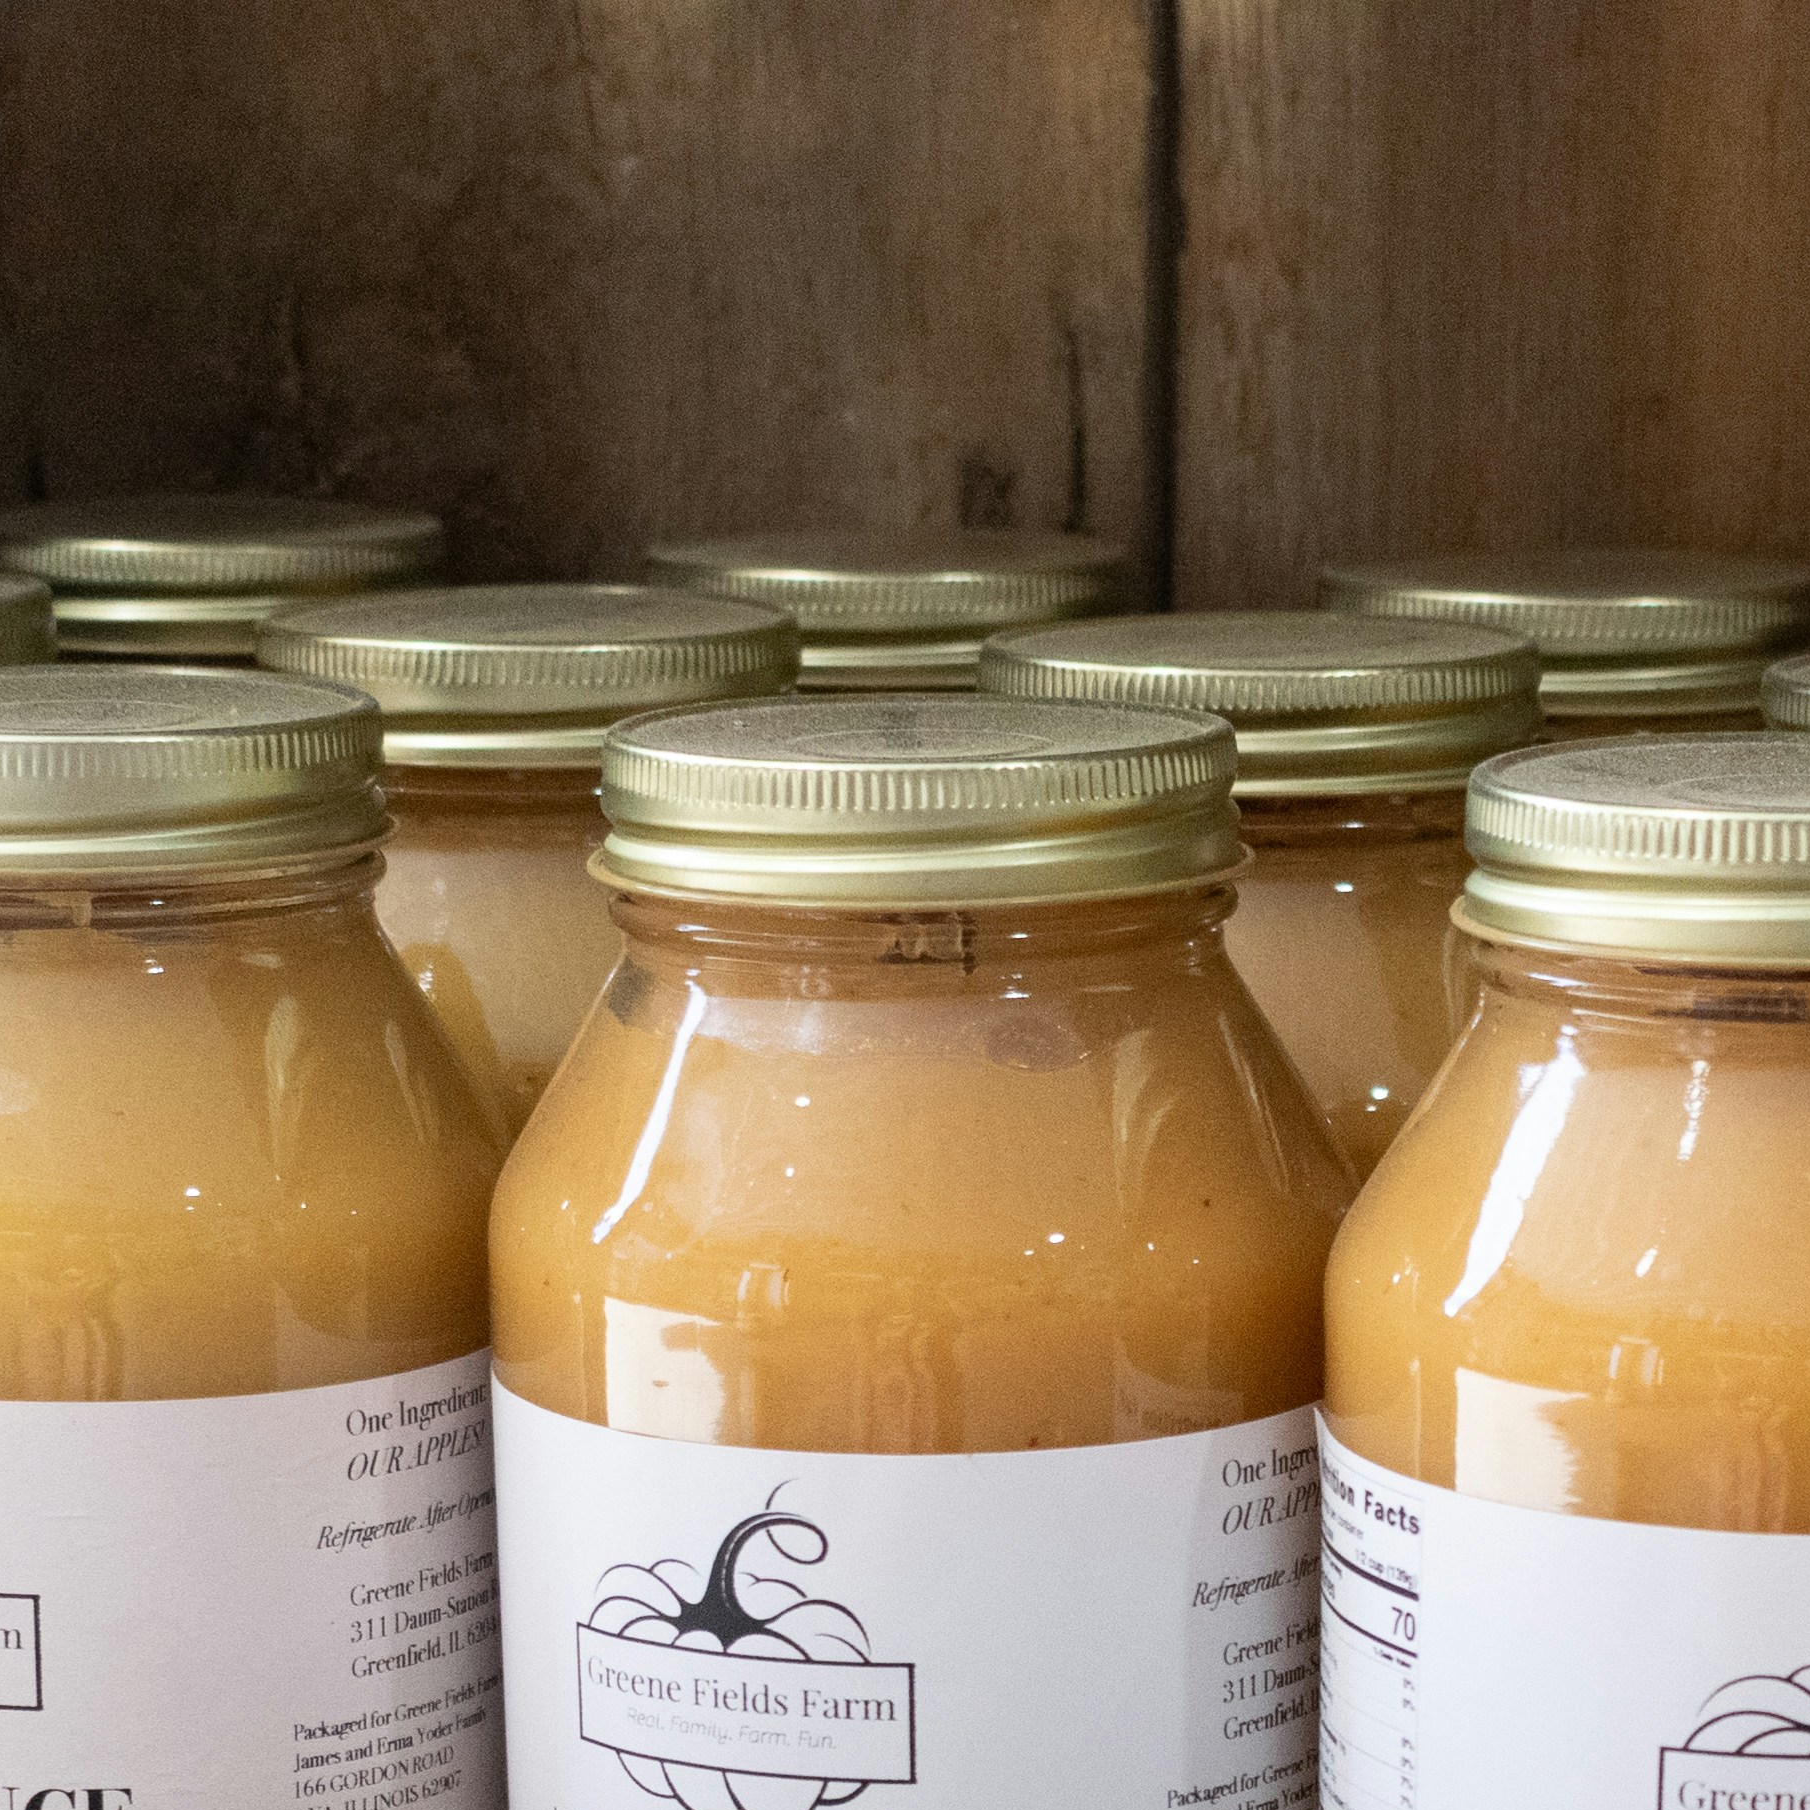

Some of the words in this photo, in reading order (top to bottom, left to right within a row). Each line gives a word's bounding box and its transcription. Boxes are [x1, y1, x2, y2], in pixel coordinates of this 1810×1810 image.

[346, 1409, 393, 1437] One
[347, 1444, 405, 1482] OUR
[1222, 1458, 1267, 1489] One
[317, 1514, 417, 1555] Refrigerate
[418, 1501, 457, 1535] After
[1221, 1495, 1276, 1536] OUR
[1362, 1488, 1422, 1536] Facts
[350, 1580, 415, 1608] Greene
[419, 1560, 463, 1593] Fields
[1191, 1568, 1286, 1612] Refrigerate
[350, 1616, 387, 1644] 311
[394, 1588, 490, 1636] Daum-Station
[1390, 1606, 1417, 1642] 70
[1223, 1634, 1284, 1666] Greene
[588, 1654, 682, 1703] Greene
[692, 1677, 789, 1718] Fields
[801, 1688, 899, 1723] Farm
[1222, 1673, 1258, 1704] 311
[294, 1711, 368, 1742] Packaged
[370, 1709, 393, 1731] for
[394, 1695, 442, 1723] Greene
[739, 1725, 791, 1748] Farm.
[797, 1729, 838, 1751] Fun.
[293, 1750, 342, 1773] James
[345, 1738, 374, 1763] and
[415, 1720, 455, 1746] Yoder
[294, 1776, 327, 1800] 166
[329, 1758, 411, 1795] GORDON
[411, 1745, 455, 1775] ROAD
[1167, 1776, 1238, 1809] Packaged
[1239, 1771, 1261, 1797] for
